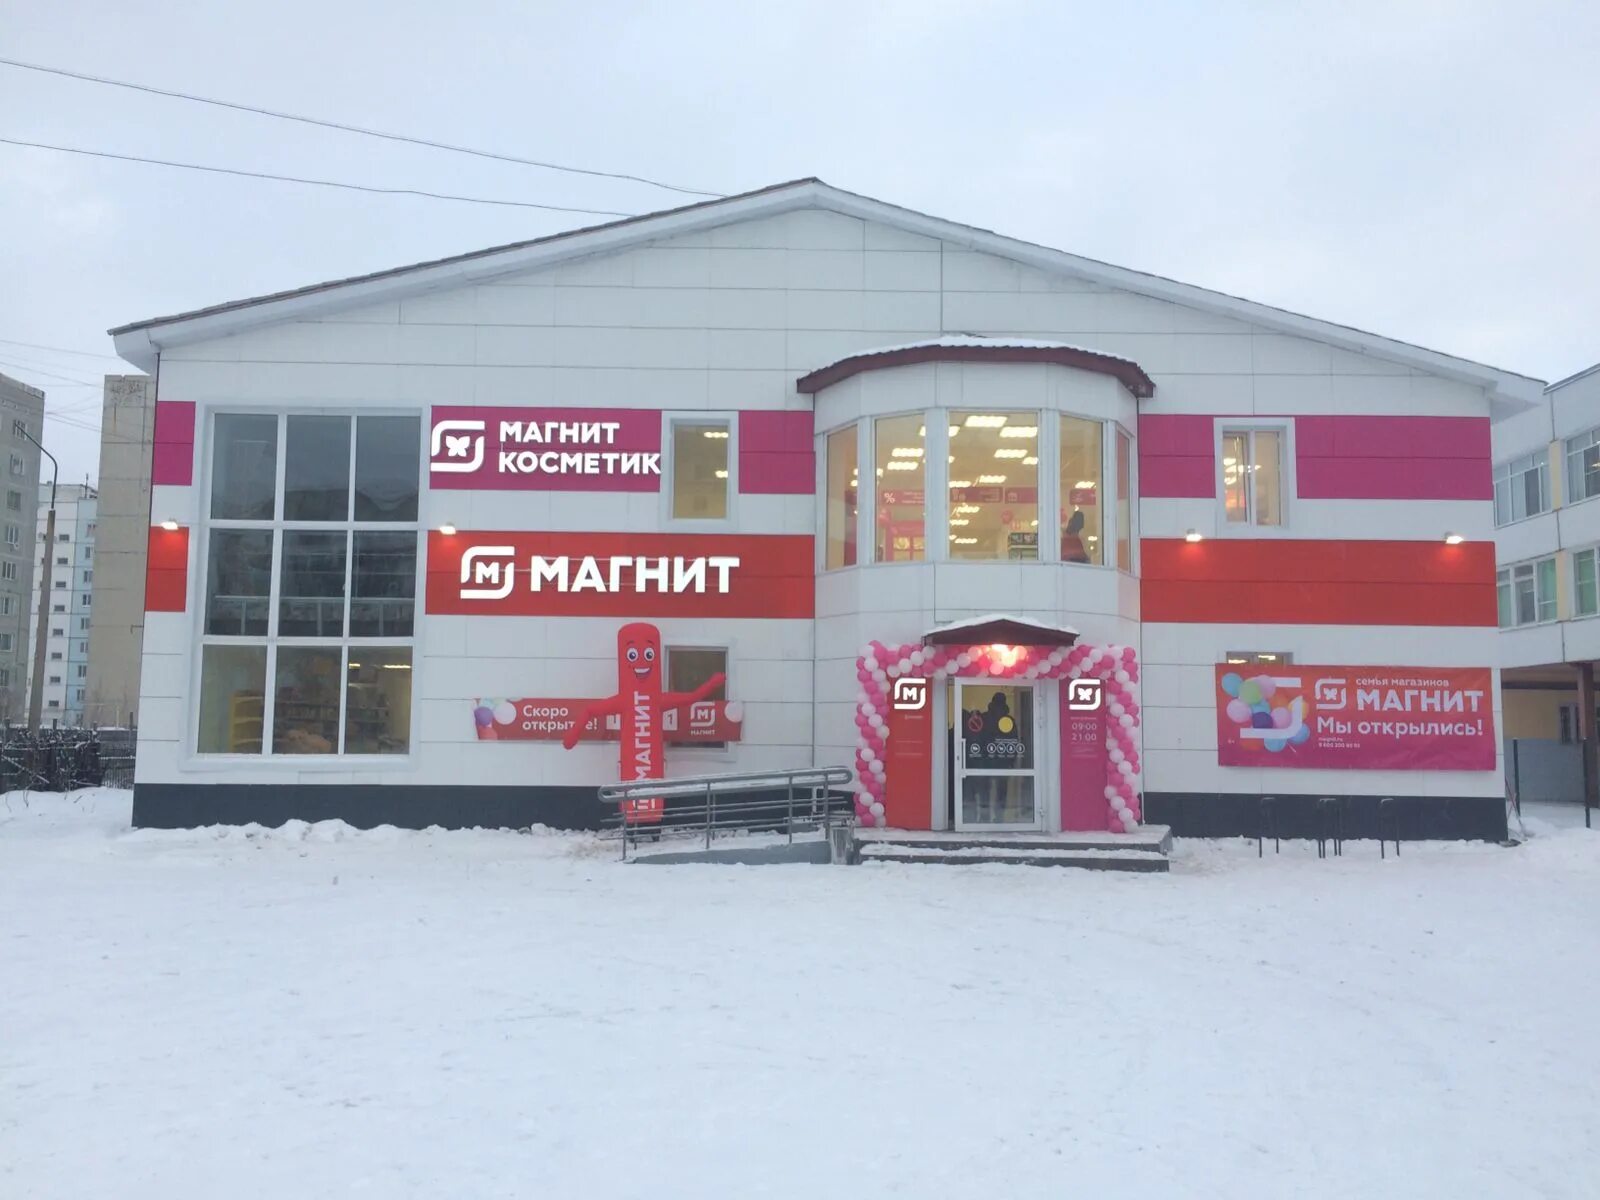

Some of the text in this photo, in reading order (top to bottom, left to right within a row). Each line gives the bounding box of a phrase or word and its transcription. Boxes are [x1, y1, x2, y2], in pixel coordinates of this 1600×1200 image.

[499, 421, 620, 444] МАГНИТ
[498, 451, 661, 475] КОСМЕТИК
[475, 561, 500, 584] М
[530, 555, 740, 594] МАГНИТ
[902, 686, 917, 701] М
[1355, 678, 1450, 688] семья магазинов
[523, 704, 569, 720] Скоро
[1356, 688, 1484, 713] МАГНИТ
[522, 717, 598, 732] открыте!
[1317, 716, 1484, 739] Мы открылись!
